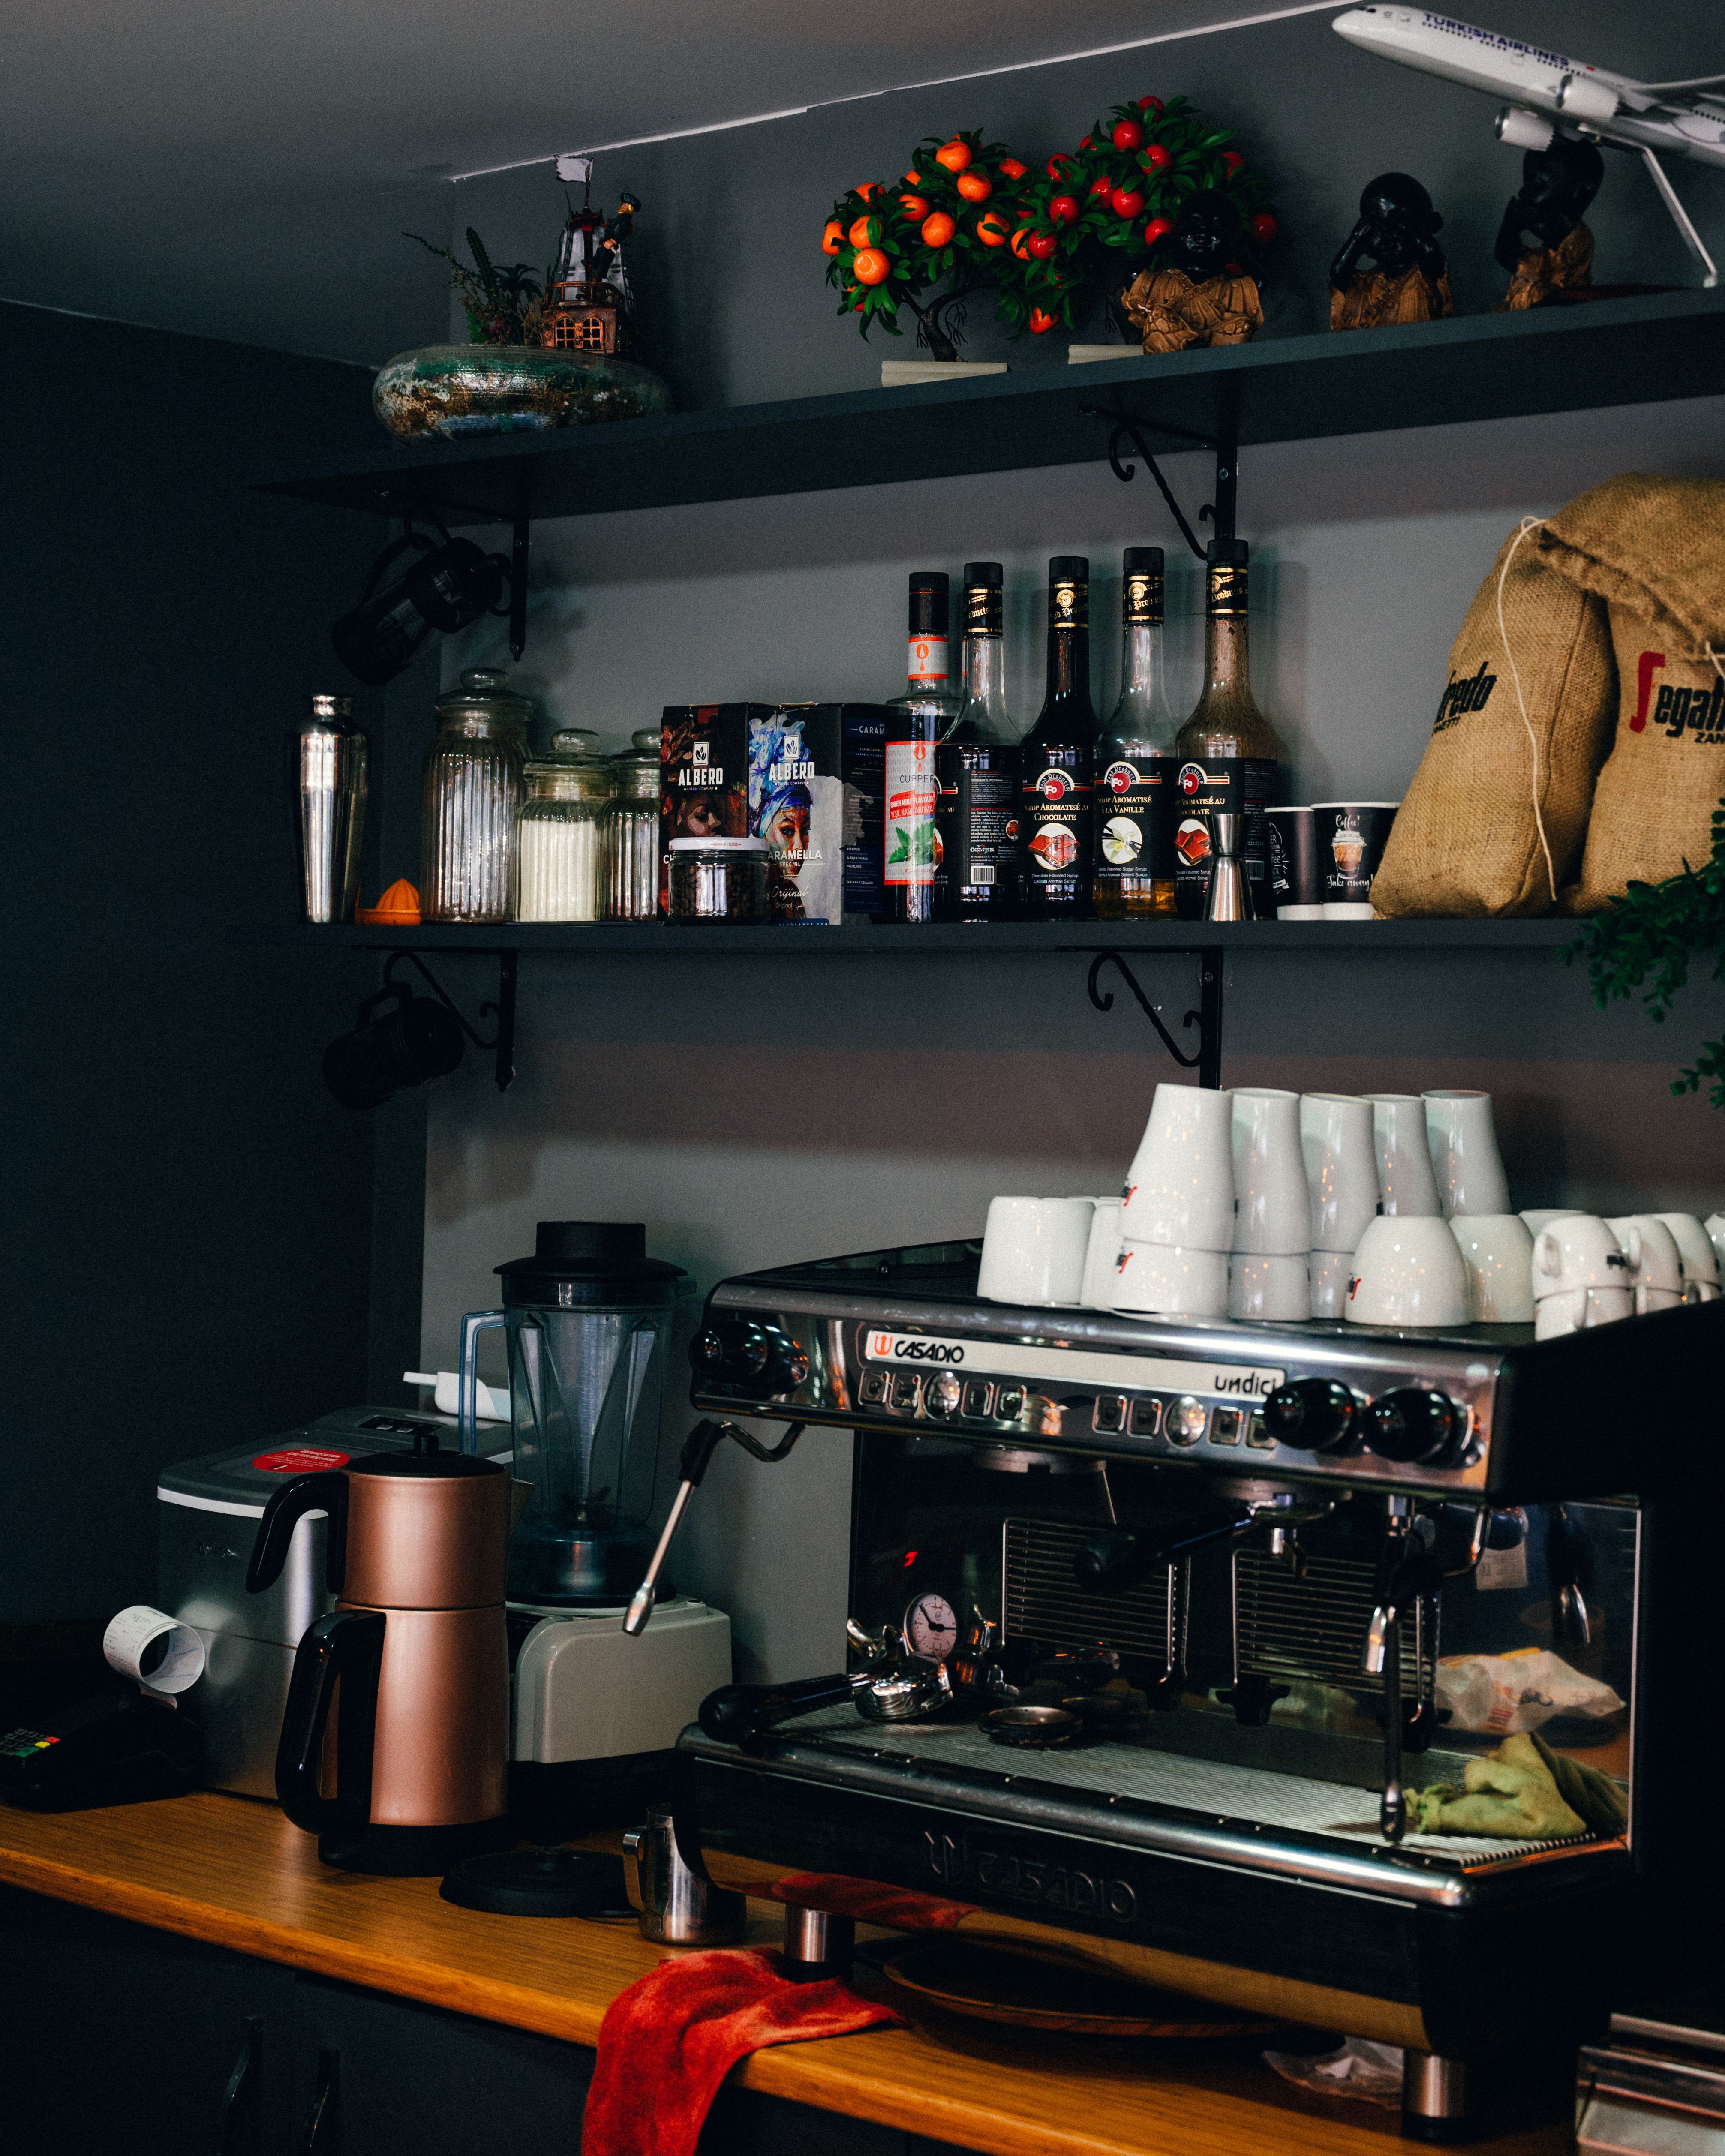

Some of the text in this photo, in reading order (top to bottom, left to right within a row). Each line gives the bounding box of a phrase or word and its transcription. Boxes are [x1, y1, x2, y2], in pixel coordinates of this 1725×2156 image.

[1424, 12, 1569, 66] TURKISH AIRLINES
[769, 761, 815, 781] ALBERO
[678, 767, 723, 786] ALBERO
[1112, 778, 1124, 788] Fo
[1183, 779, 1193, 789] Fo
[1045, 785, 1058, 795] Fo
[913, 796, 933, 804] FLAVOUR
[1034, 812, 1077, 820] CHOCOLATE
[767, 850, 823, 860] ARAMELLA
[772, 884, 809, 901] Orijinal
[894, 1340, 965, 1363] CASADIO
